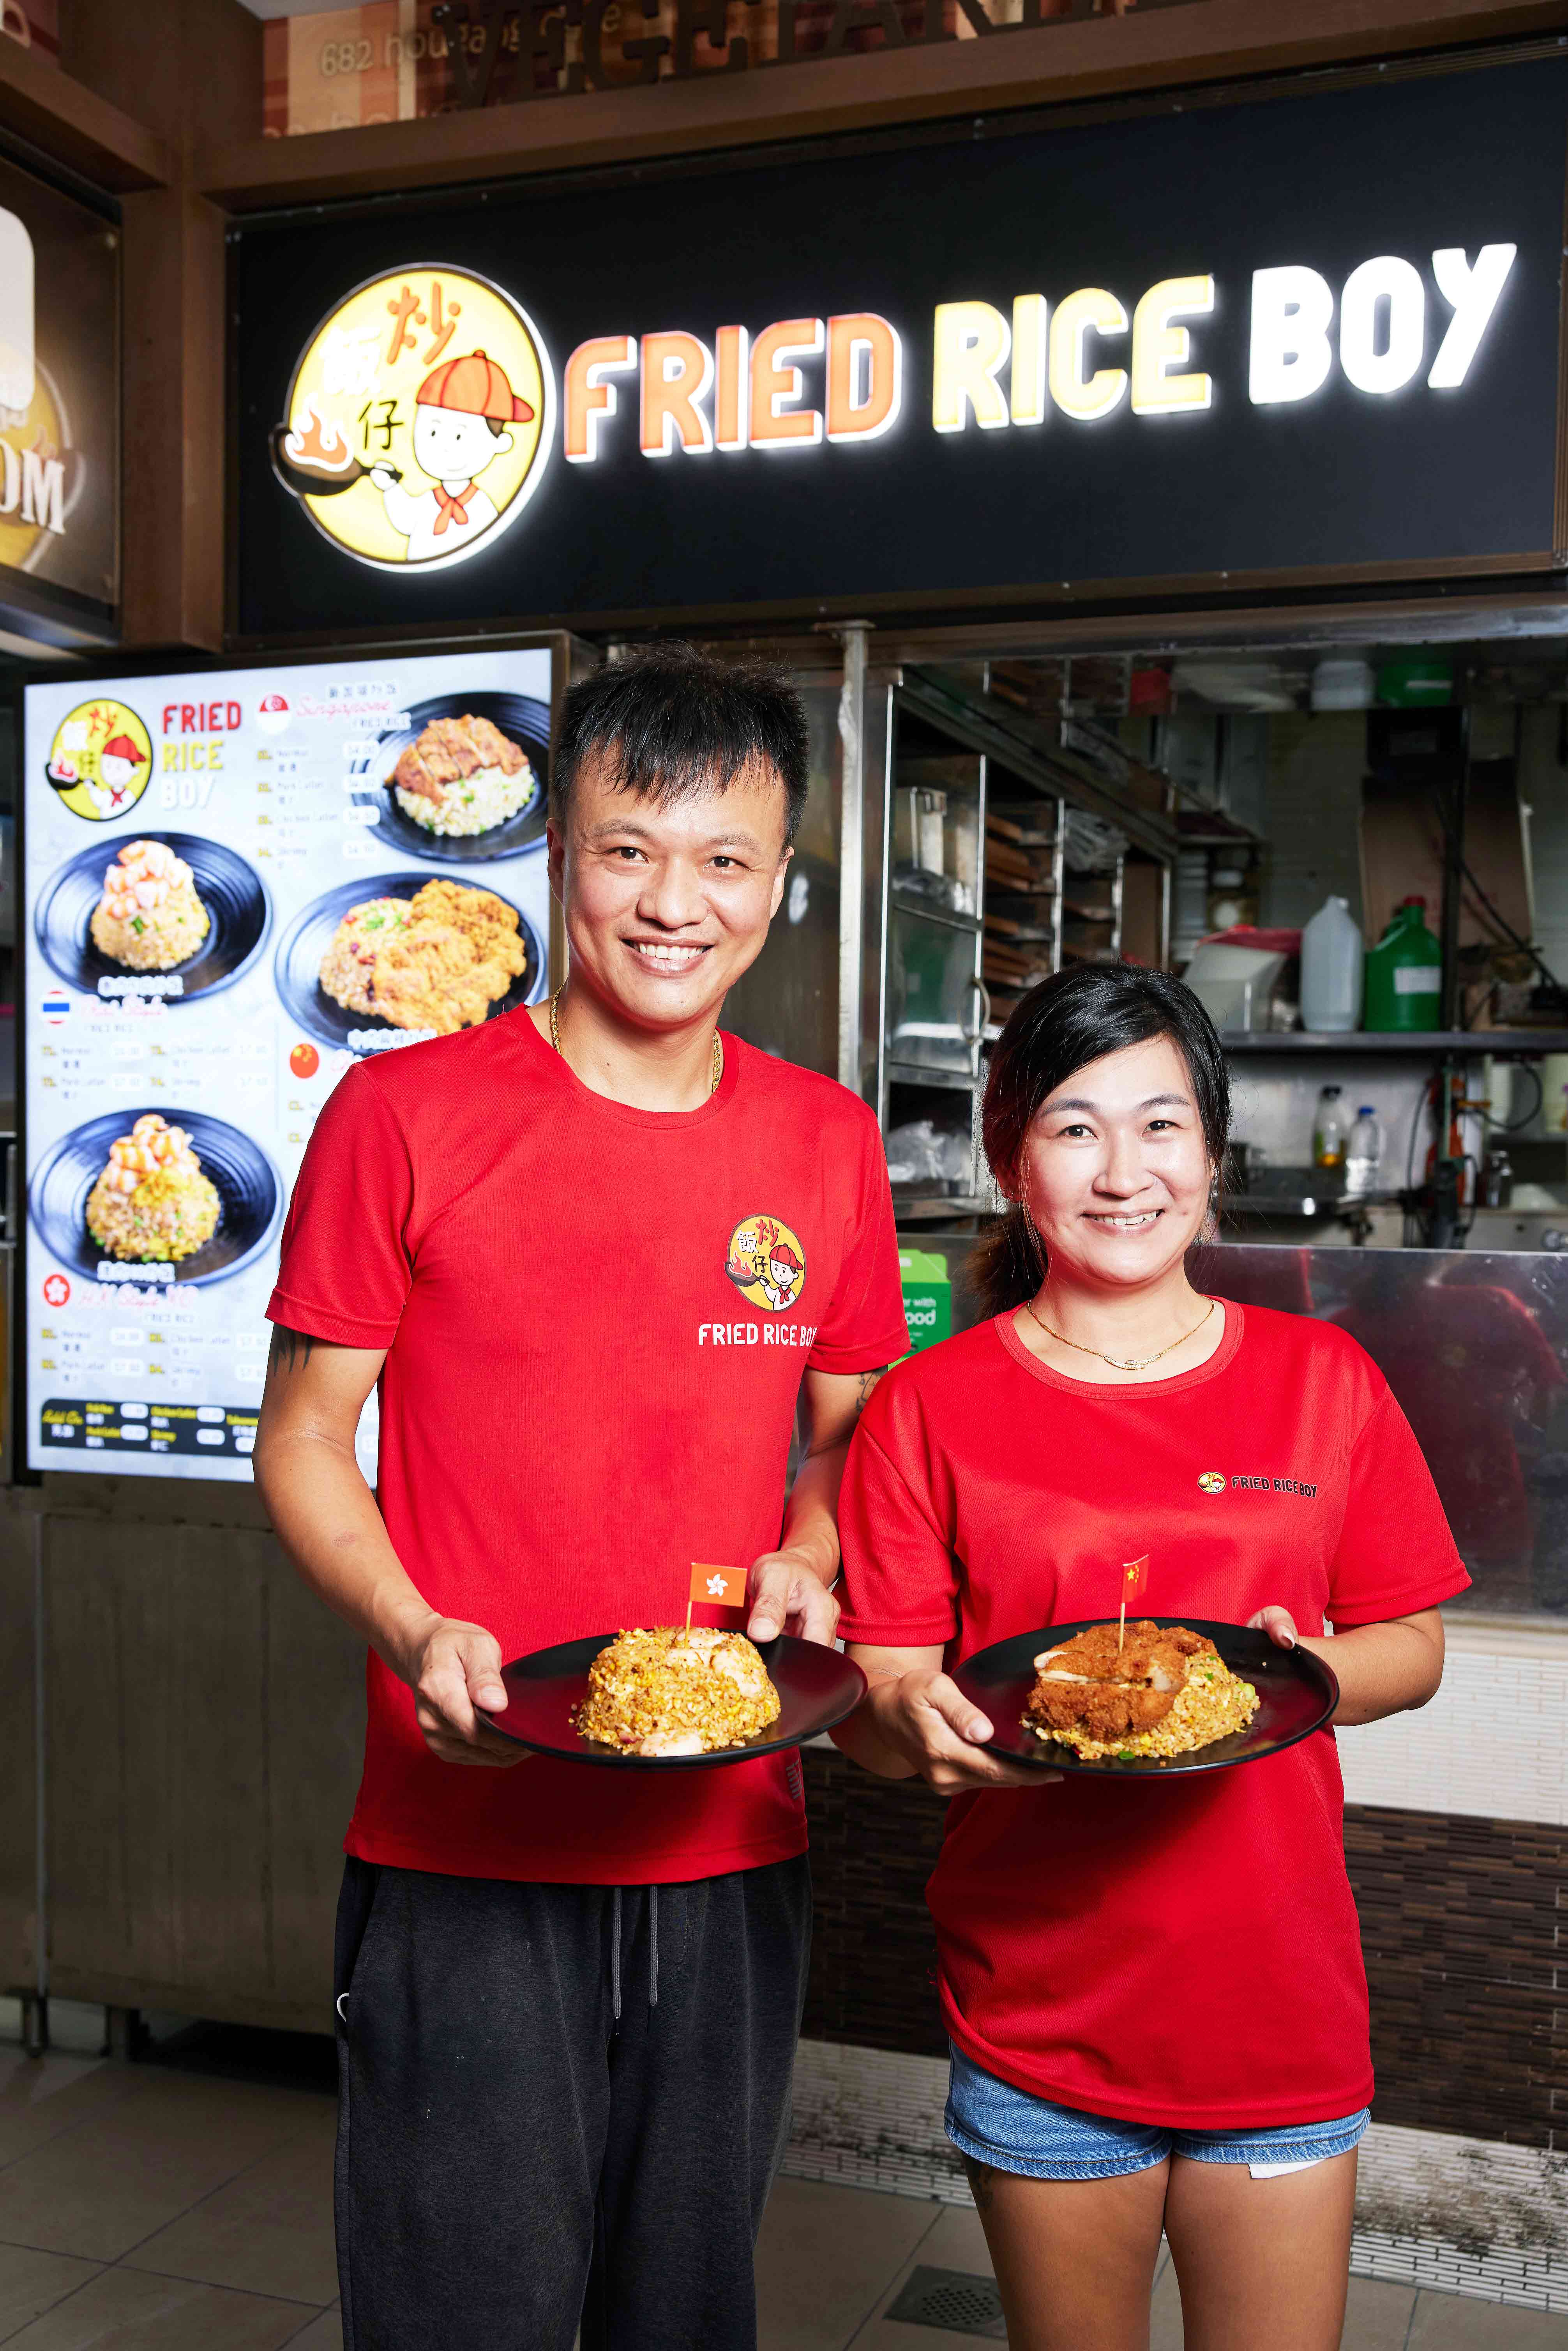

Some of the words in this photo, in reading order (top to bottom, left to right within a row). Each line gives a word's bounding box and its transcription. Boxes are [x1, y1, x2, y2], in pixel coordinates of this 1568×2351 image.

[320, 39, 374, 77] 682
[387, 281, 461, 365] 炒
[564, 313, 902, 463] FRIED
[932, 274, 1215, 433] RICE
[1248, 243, 1517, 405] BOY
[358, 400, 404, 450] 仔
[162, 701, 242, 734] FRIED
[162, 740, 224, 772] RICE
[161, 777, 216, 810] BOY
[737, 1230, 759, 1254] 飯
[755, 1218, 779, 1247] 炒
[752, 1255, 768, 1273] 仔
[905, 1309, 936, 1326] ood
[699, 1323, 758, 1345] FRIED
[764, 1323, 797, 1347] RICE
[800, 1325, 818, 1348] BOY
[1232, 1476, 1270, 1490] FRIED
[1273, 1478, 1298, 1494] RICE
[1300, 1482, 1317, 1498] BOY
